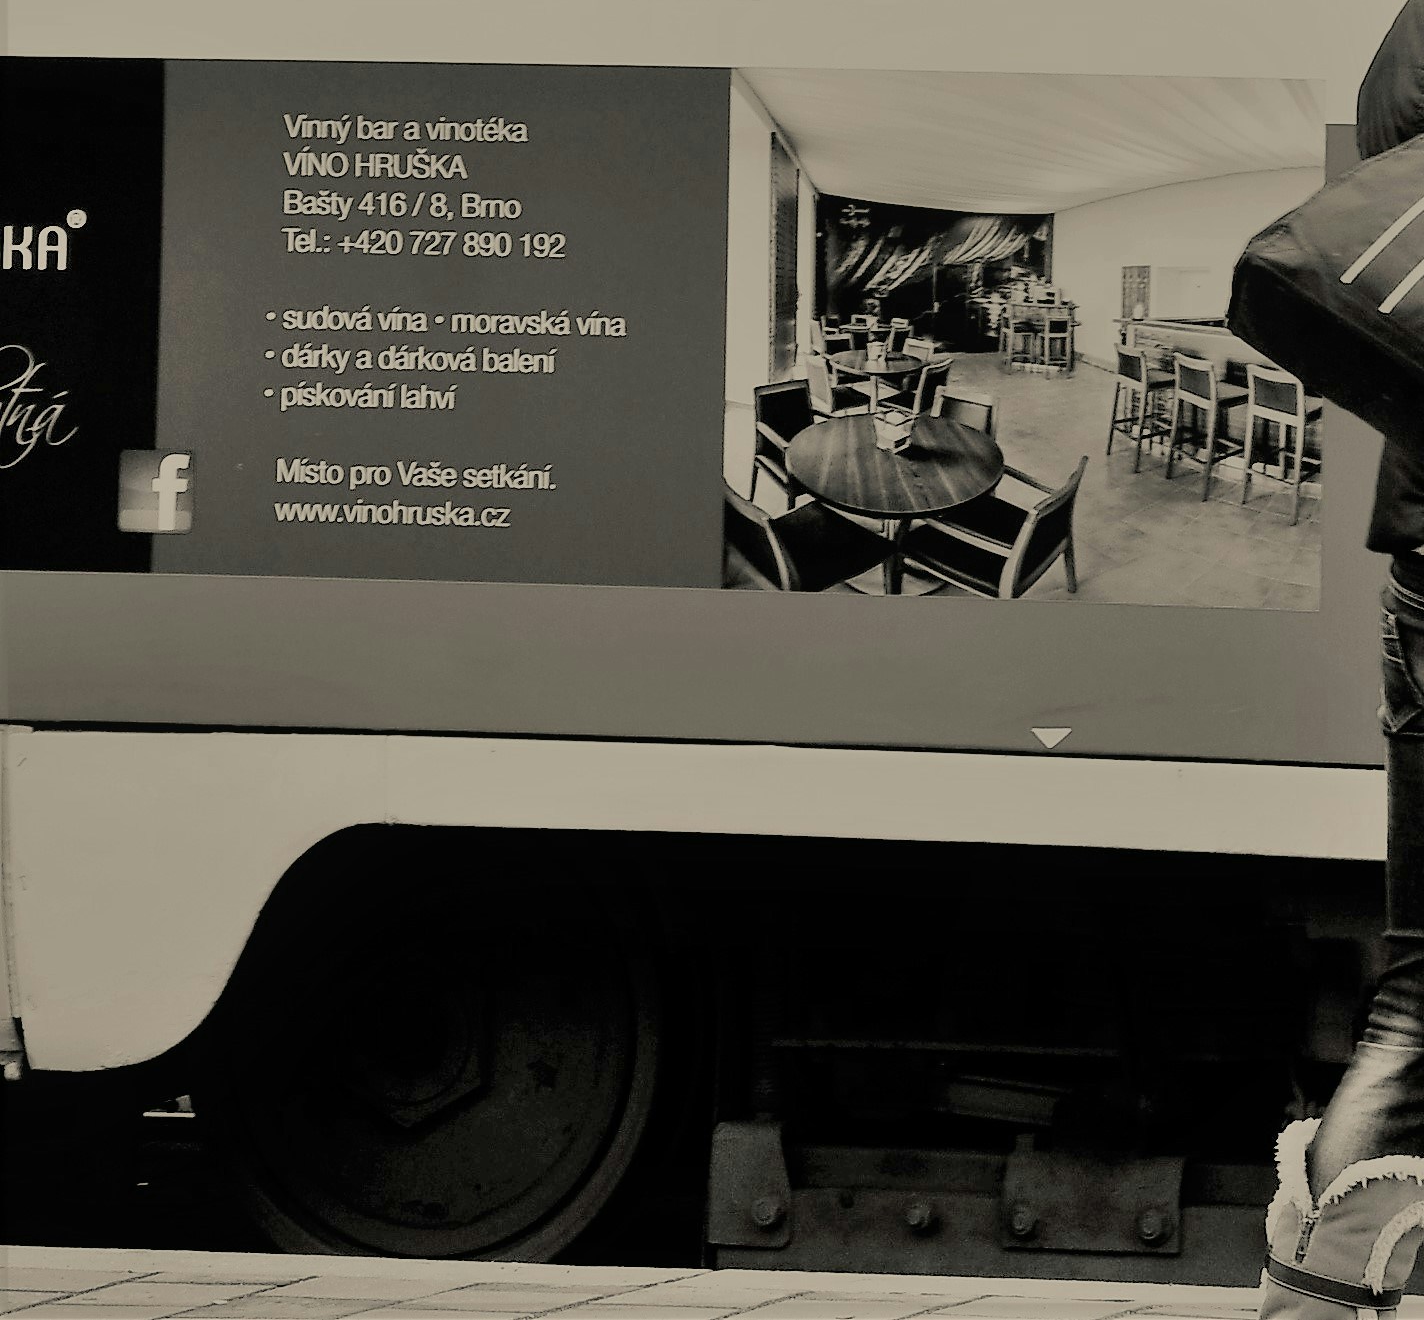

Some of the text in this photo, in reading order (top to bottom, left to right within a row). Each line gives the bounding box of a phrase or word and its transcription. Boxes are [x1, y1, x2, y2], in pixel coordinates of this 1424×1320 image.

[283, 114, 529, 145] Vinný bar a vinotéka
[283, 146, 468, 179] VÍNO HRUŠKA
[283, 189, 353, 220] Bašty
[357, 192, 407, 217] 416
[429, 193, 455, 220] 8,
[461, 193, 522, 219] Brno
[281, 227, 566, 258] Tel.: +420 727 890 192
[282, 305, 627, 337] sudová vína moravská vína
[280, 343, 558, 374] dárky a dárková balení
[280, 382, 457, 411] pískování lahví
[275, 458, 556, 490] Místo pro Vaše setkání.
[274, 499, 511, 528] www.vinohruska.cz
